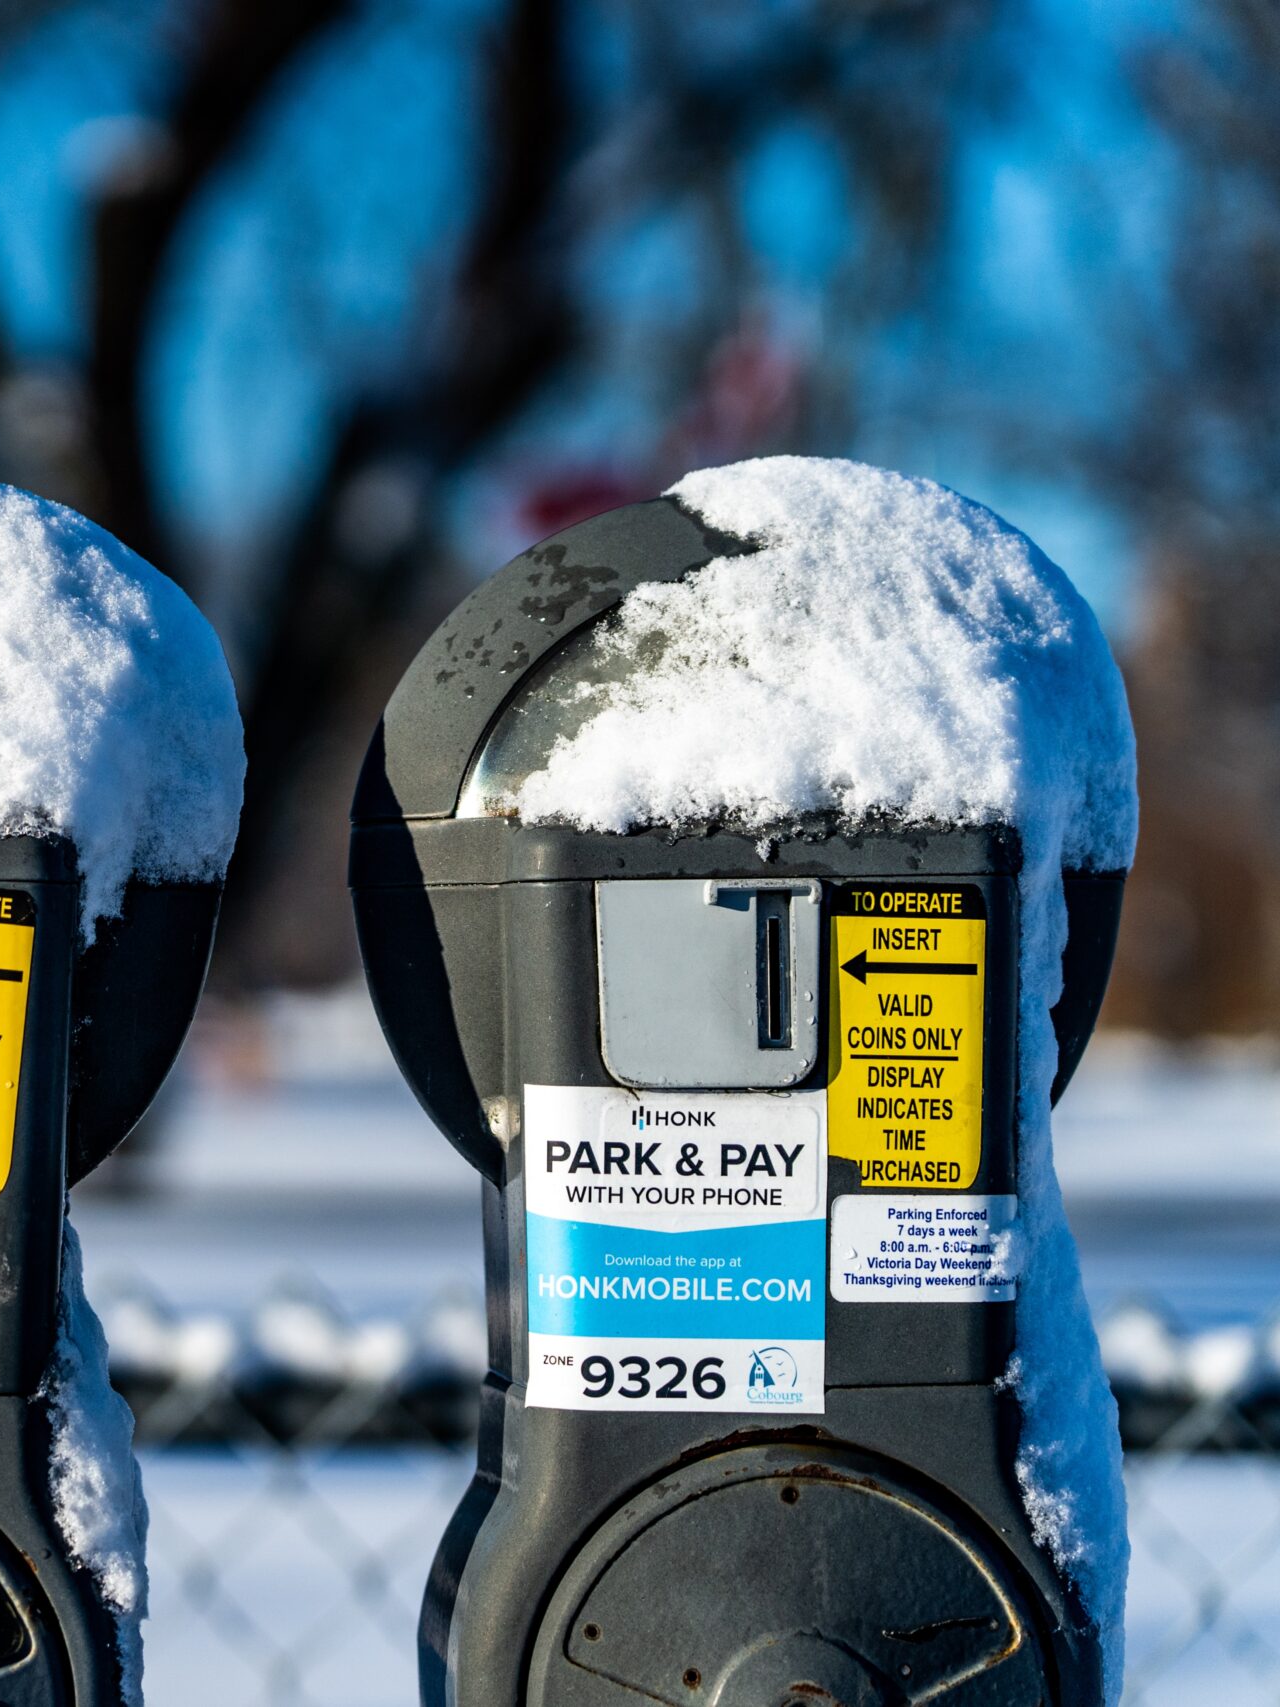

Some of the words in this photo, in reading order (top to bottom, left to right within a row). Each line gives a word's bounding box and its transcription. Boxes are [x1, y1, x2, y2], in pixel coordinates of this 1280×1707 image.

[851, 891, 875, 912] TO
[879, 892, 963, 913] OPERATE
[872, 928, 941, 951] INSERT
[878, 993, 933, 1017] VALID
[848, 1026, 906, 1050] COINS
[912, 1027, 963, 1051] ONLY
[867, 1066, 944, 1089] DISPLAY
[655, 1111, 716, 1127] HONK
[856, 1097, 954, 1121] INDICATES
[882, 1129, 926, 1151] TIME
[546, 1140, 662, 1176] PARK
[675, 1142, 705, 1176] &
[720, 1143, 805, 1177] PAY
[858, 1159, 961, 1183] URCHASED
[566, 1186, 624, 1204] WITH
[631, 1186, 695, 1205] YOUR
[702, 1187, 783, 1206] PHONE
[888, 1208, 932, 1222] Parking
[935, 1208, 988, 1221] Enforced
[897, 1224, 904, 1236] 7
[907, 1224, 935, 1239] days
[938, 1228, 945, 1237] a
[949, 1225, 978, 1237] week
[880, 1241, 905, 1253] 8:00
[907, 1243, 932, 1253] a.m.
[604, 1253, 671, 1267] Download
[675, 1254, 696, 1267] the
[700, 1257, 725, 1269] app
[729, 1256, 742, 1267] at
[867, 1257, 911, 1269] Victoria
[915, 1258, 937, 1272] Day
[940, 1257, 992, 1270] Weekend
[538, 1273, 811, 1302] HONKMOBILE.COM
[844, 1272, 922, 1288] Thanksgiving
[925, 1274, 976, 1287] weekend
[543, 1354, 574, 1366] ZONE
[580, 1354, 727, 1400] 9326
[747, 1387, 803, 1403] Cobourg
